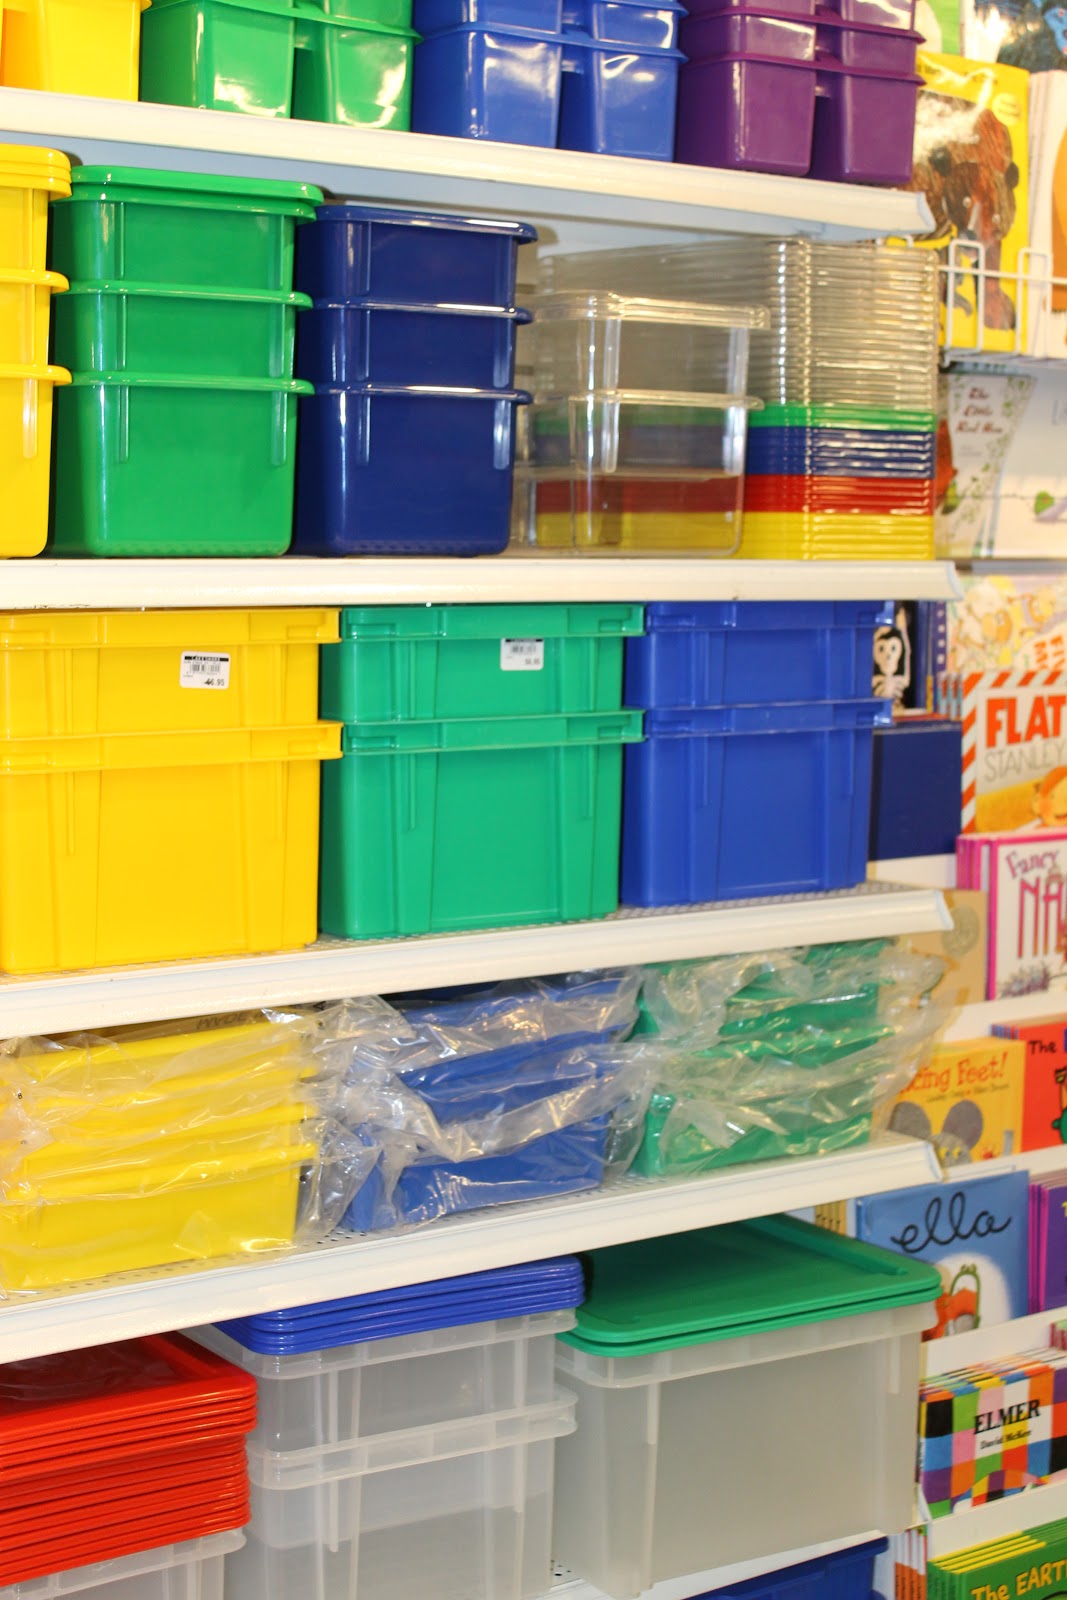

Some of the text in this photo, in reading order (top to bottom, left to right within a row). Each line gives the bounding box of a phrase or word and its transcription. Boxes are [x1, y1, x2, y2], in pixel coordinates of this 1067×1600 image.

[986, 695, 1066, 749] FLAT
[984, 740, 1066, 783] STANLEY
[1005, 850, 1060, 879] Fancy
[1018, 876, 1067, 958] NA
[1028, 1040, 1057, 1055] The
[957, 1051, 1008, 1085] Feet!
[890, 1190, 1013, 1253] ella
[973, 1399, 1041, 1435] ELMER
[980, 1437, 1004, 1449] David
[970, 1584, 1010, 1600] The
[1016, 1559, 1067, 1596] EART
